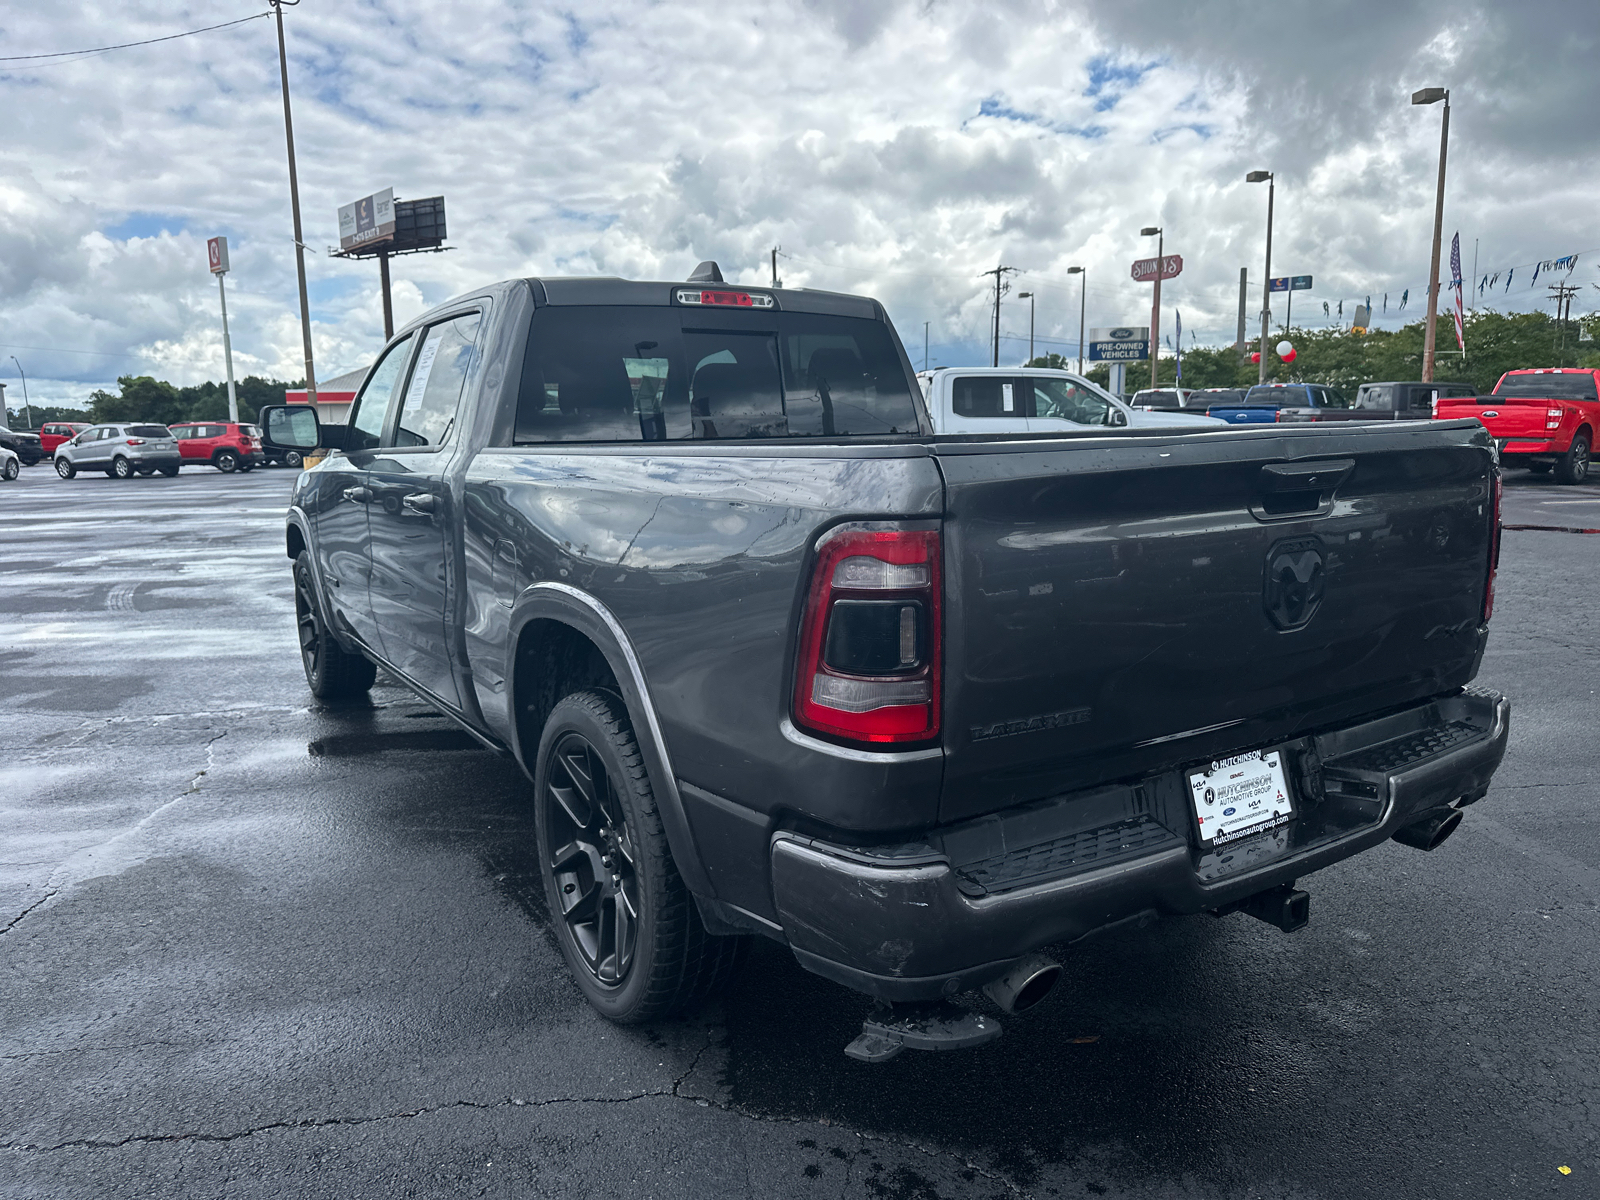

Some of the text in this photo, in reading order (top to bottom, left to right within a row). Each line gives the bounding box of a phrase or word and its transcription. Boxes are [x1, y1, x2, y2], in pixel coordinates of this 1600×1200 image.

[365, 228, 376, 240] EXIT
[1097, 343, 1144, 351] PRE-OWNED
[1101, 350, 1140, 359] VEHICLES
[969, 707, 1092, 742] LARAMIE
[1220, 749, 1262, 769] HUTCHINSON
[1217, 773, 1272, 799] HUTCHINSON
[1220, 785, 1272, 806] AUTOMOTIVE GROUP
[1213, 815, 1289, 845] Hutchinsonautogroup.com
